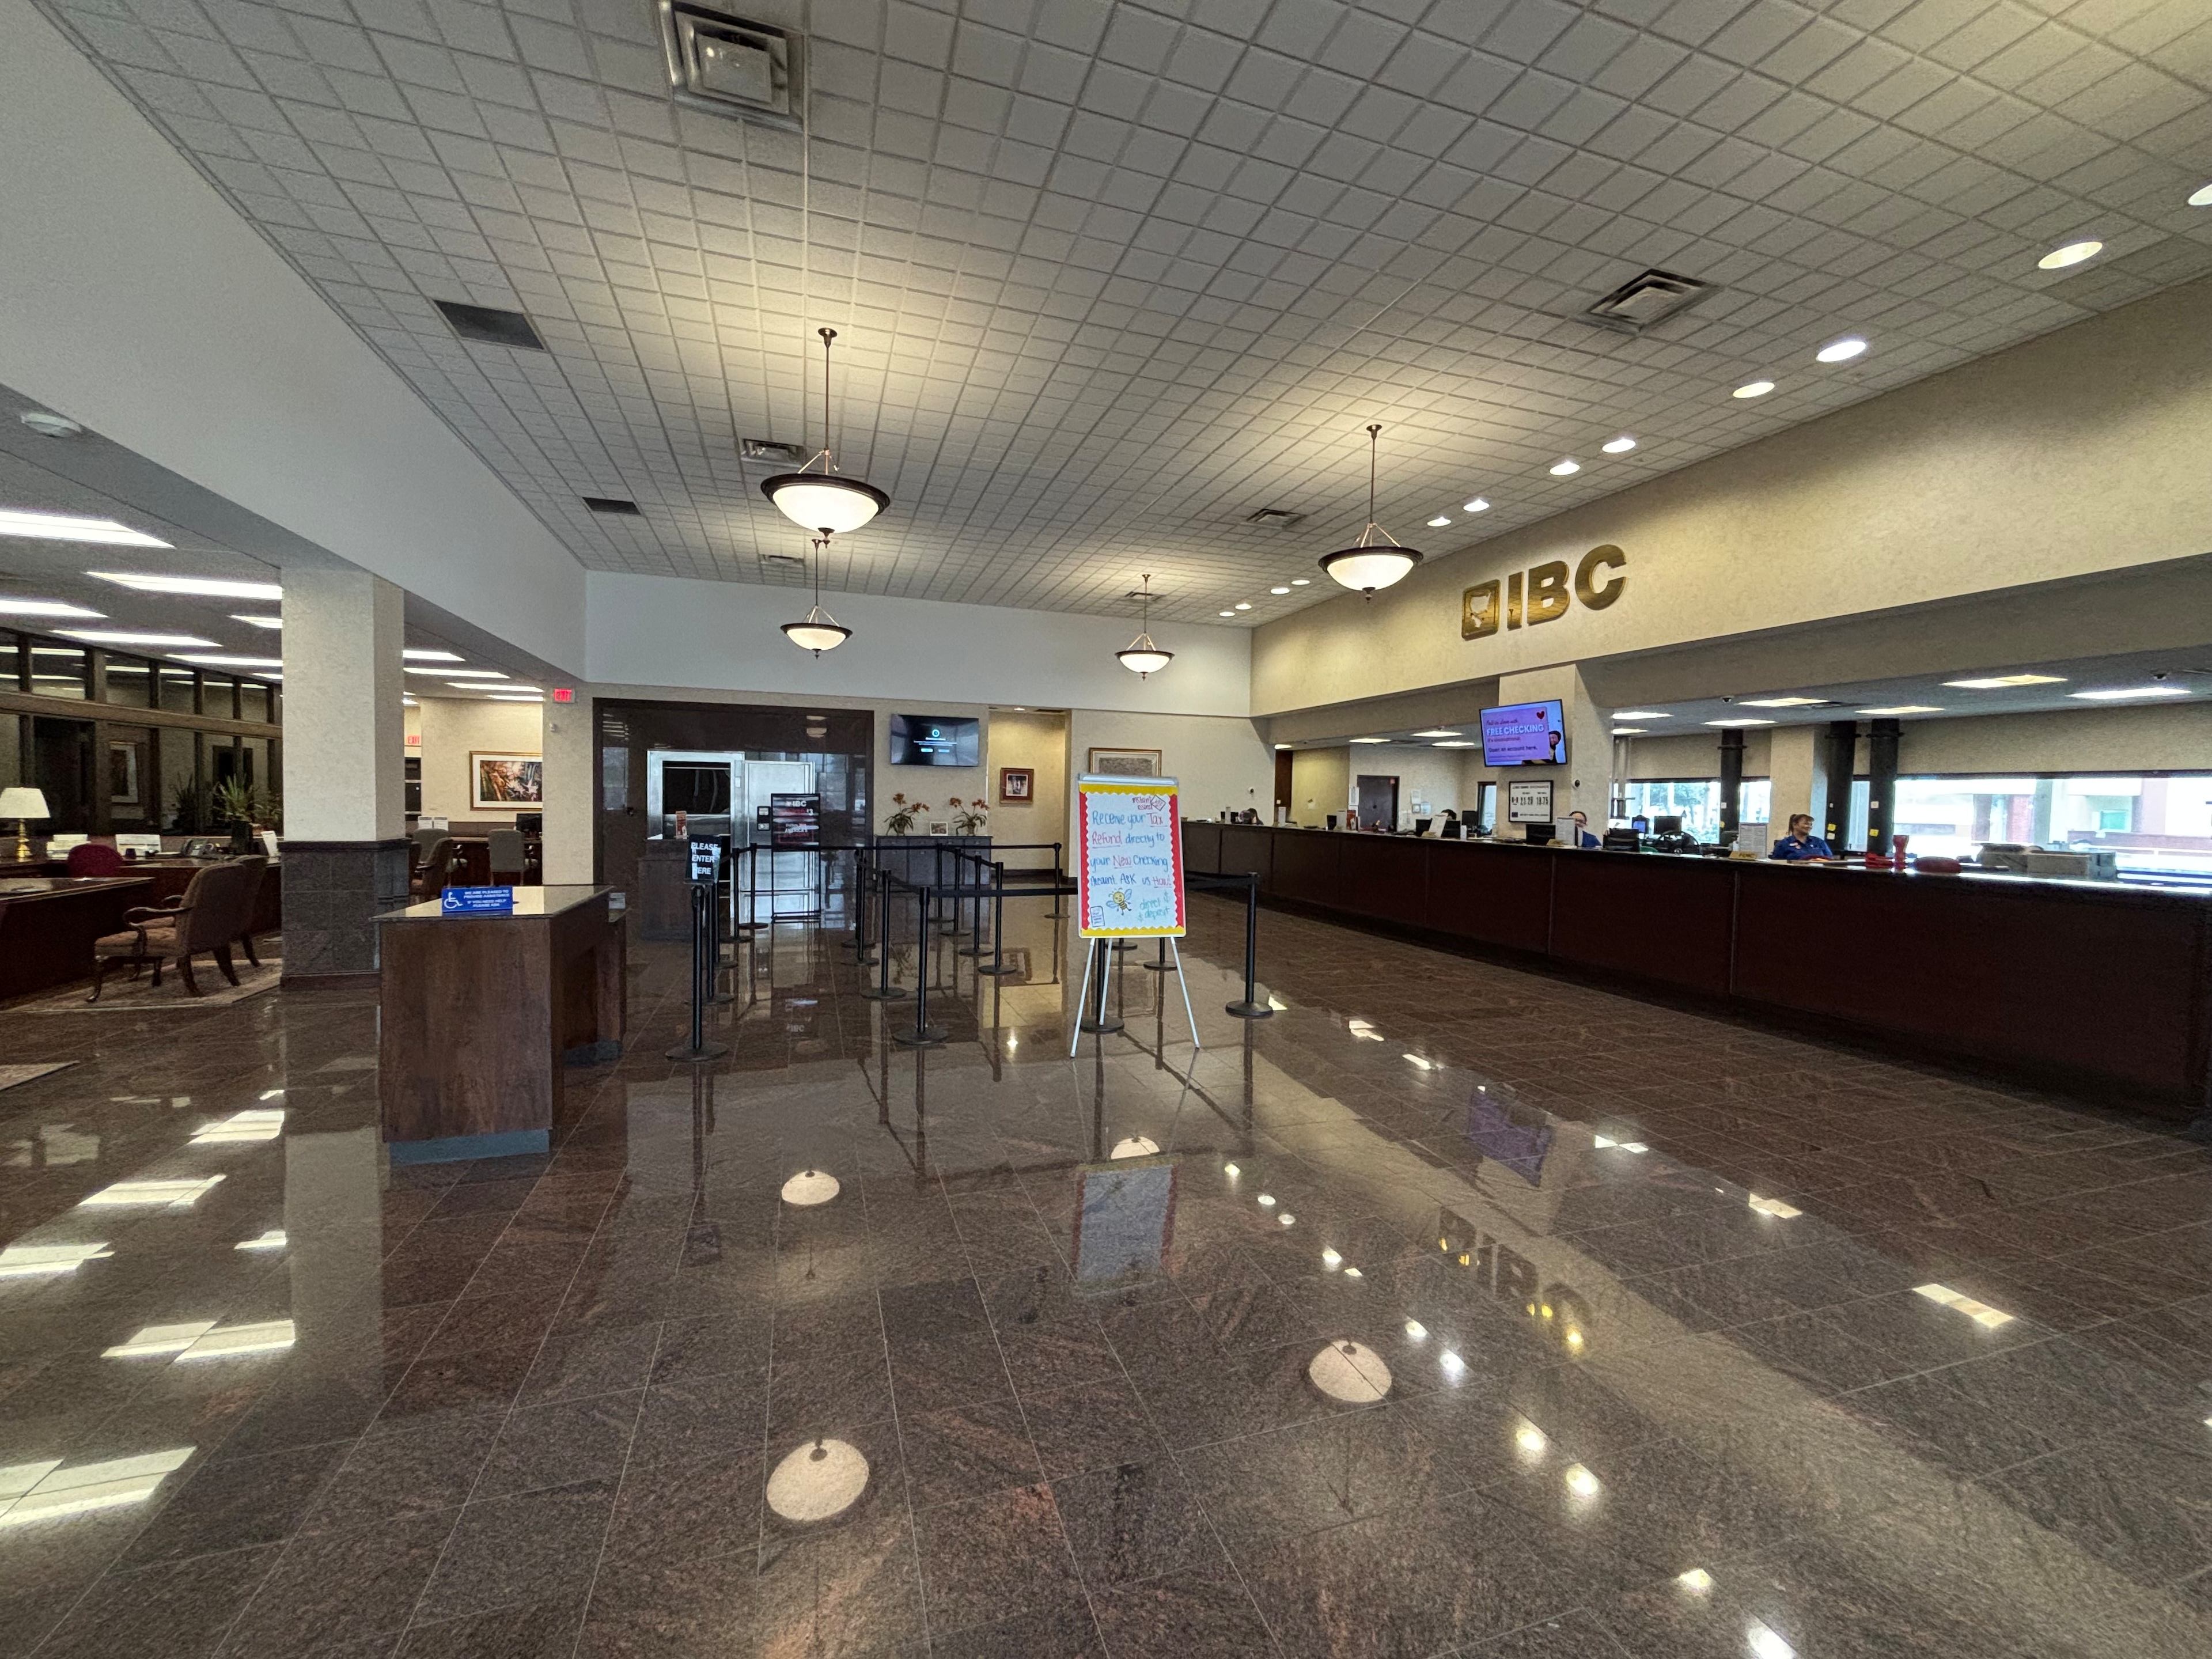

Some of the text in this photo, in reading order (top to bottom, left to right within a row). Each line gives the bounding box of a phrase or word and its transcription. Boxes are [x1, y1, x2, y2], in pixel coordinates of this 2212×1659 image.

[1507, 544, 1627, 631] IBC
[1487, 724, 1544, 736] FREE CHECKING
[408, 736, 420, 744] EXIT
[1092, 810, 1163, 830] Receive your Tax
[1092, 831, 1165, 847] Refund directly to
[691, 842, 718, 851] PLEASE
[692, 854, 714, 862] ENTER
[1090, 855, 1168, 873] your New Checking
[1090, 875, 1116, 887] Account
[1142, 877, 1151, 885] us
[1152, 875, 1172, 886] How!
[1140, 897, 1161, 910] direct
[1145, 906, 1171, 920] deposit
